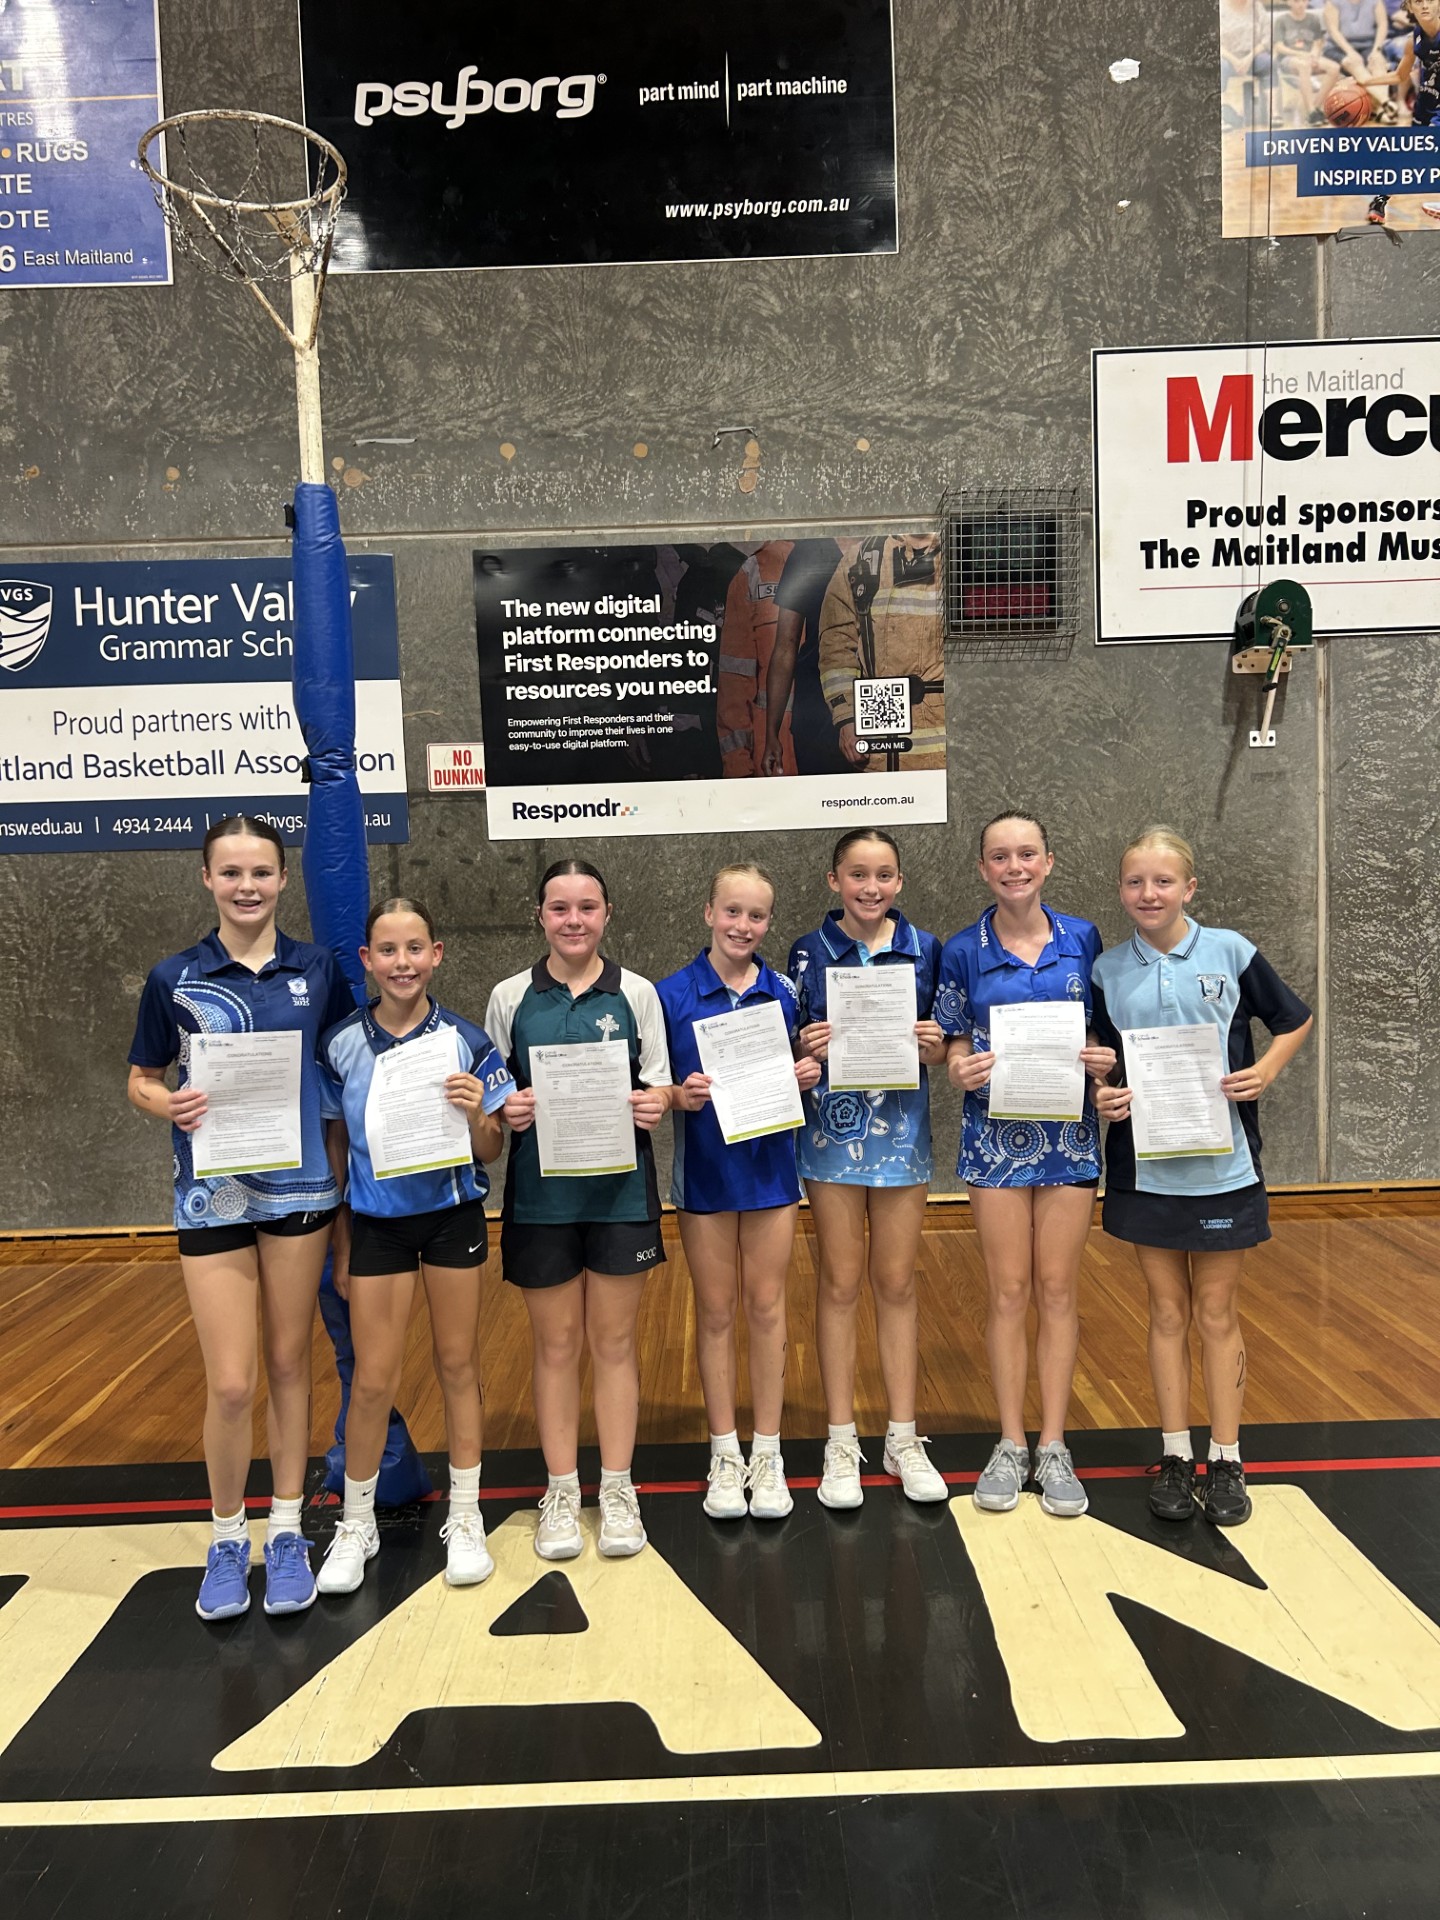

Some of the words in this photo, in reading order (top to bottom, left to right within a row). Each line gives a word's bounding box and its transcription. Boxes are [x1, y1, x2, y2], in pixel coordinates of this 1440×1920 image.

[639, 83, 675, 106] part
[678, 80, 720, 100] mind
[737, 79, 772, 101] part
[776, 75, 847, 97] machine
[16, 141, 89, 163] RUGS
[1263, 137, 1334, 156] DRIVEN
[1339, 136, 1362, 153] BY
[1366, 135, 1439, 154] VALUES,
[0, 174, 33, 194] TE
[1314, 169, 1397, 187] INSPIRED
[1402, 168, 1426, 184] BY
[665, 197, 850, 219] www.psyborg.com.au
[23, 249, 60, 266] East
[65, 249, 134, 265] Maitland
[1262, 373, 1299, 394] the
[1307, 368, 1405, 393] Maitland
[1187, 495, 1287, 528] Proud
[1140, 538, 1200, 569] The
[1212, 531, 1366, 567] Maitland
[75, 586, 219, 627] Hunter
[500, 599, 542, 618] The
[546, 601, 590, 616] new
[594, 594, 661, 618] digital
[502, 625, 595, 649] platform
[598, 620, 717, 643] connecting
[99, 633, 234, 662] Grammar
[504, 653, 553, 672] First
[556, 650, 683, 673] Responders
[686, 650, 709, 667] to
[506, 682, 612, 700] resources
[615, 681, 655, 700] you
[658, 675, 717, 694] need.
[53, 708, 123, 735] Proud
[132, 709, 233, 740] partners
[239, 704, 291, 730] with
[507, 717, 561, 728] Empowering
[562, 716, 581, 725] First
[583, 714, 634, 725] Responders
[636, 713, 653, 722] and
[654, 713, 674, 722] their
[508, 729, 556, 740] community
[558, 729, 567, 738] to
[568, 728, 603, 738] improve
[605, 726, 624, 735] their
[626, 725, 645, 734] lives
[647, 725, 655, 733] in
[656, 725, 673, 733] one
[508, 741, 561, 752] easy-to-use
[562, 740, 589, 750] digital
[590, 738, 629, 749] platform.
[870, 742, 892, 750] SCAN
[893, 741, 905, 750] ME
[83, 749, 225, 778] Basketball
[453, 750, 472, 766] NO
[434, 769, 486, 786] DUNKIN
[512, 799, 621, 823] Respondr
[821, 796, 915, 809] respondr.com.au
[112, 816, 150, 834] 4934
[154, 813, 193, 832] 2444
[487, 1067, 514, 1092] 20
